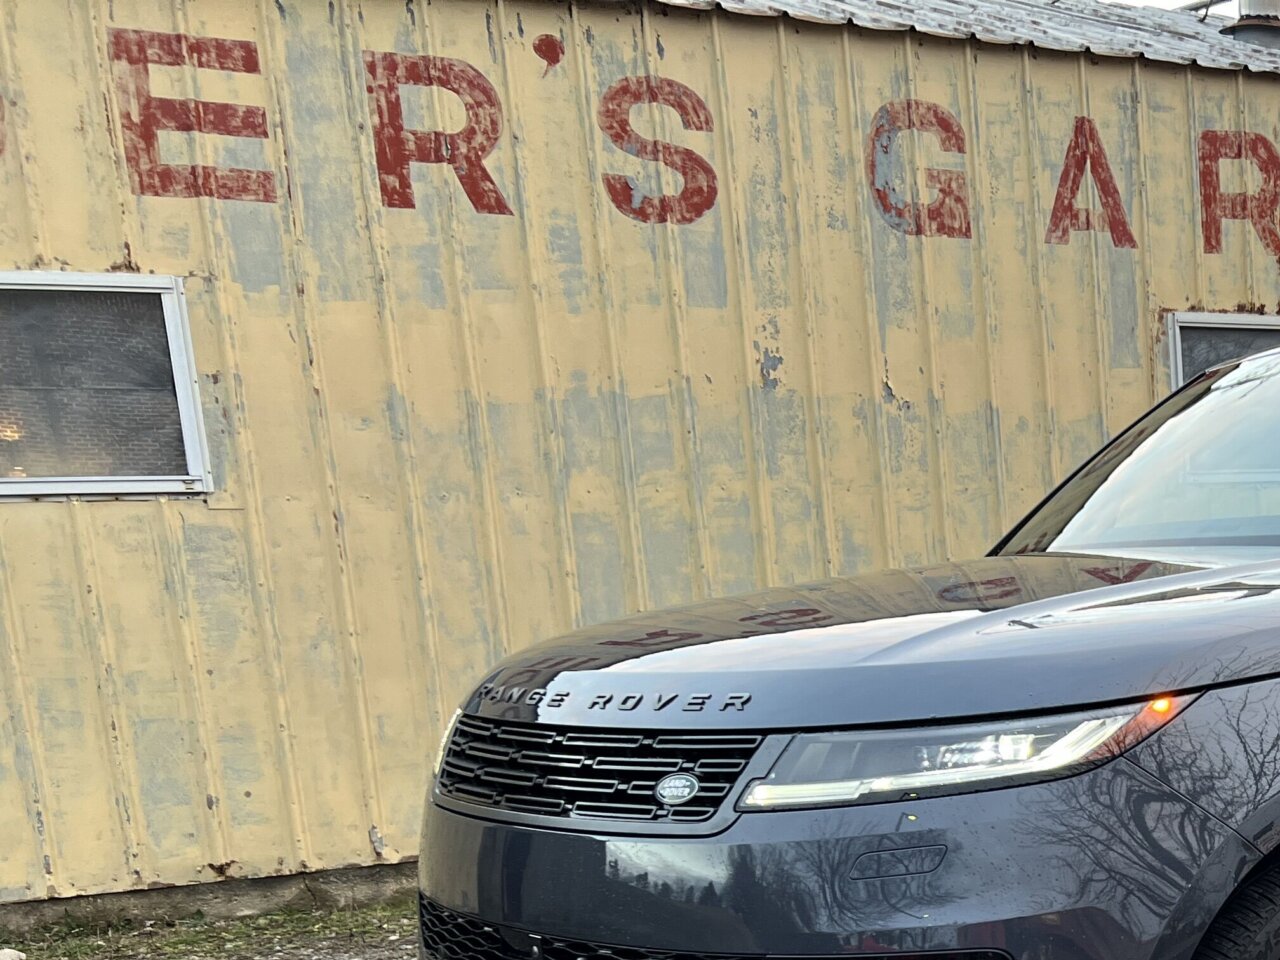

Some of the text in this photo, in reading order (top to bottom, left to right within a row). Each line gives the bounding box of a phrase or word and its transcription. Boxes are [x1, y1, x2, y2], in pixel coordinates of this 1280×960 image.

[0, 27, 719, 226] ER'S
[477, 683, 752, 712] RANGE ROVER
